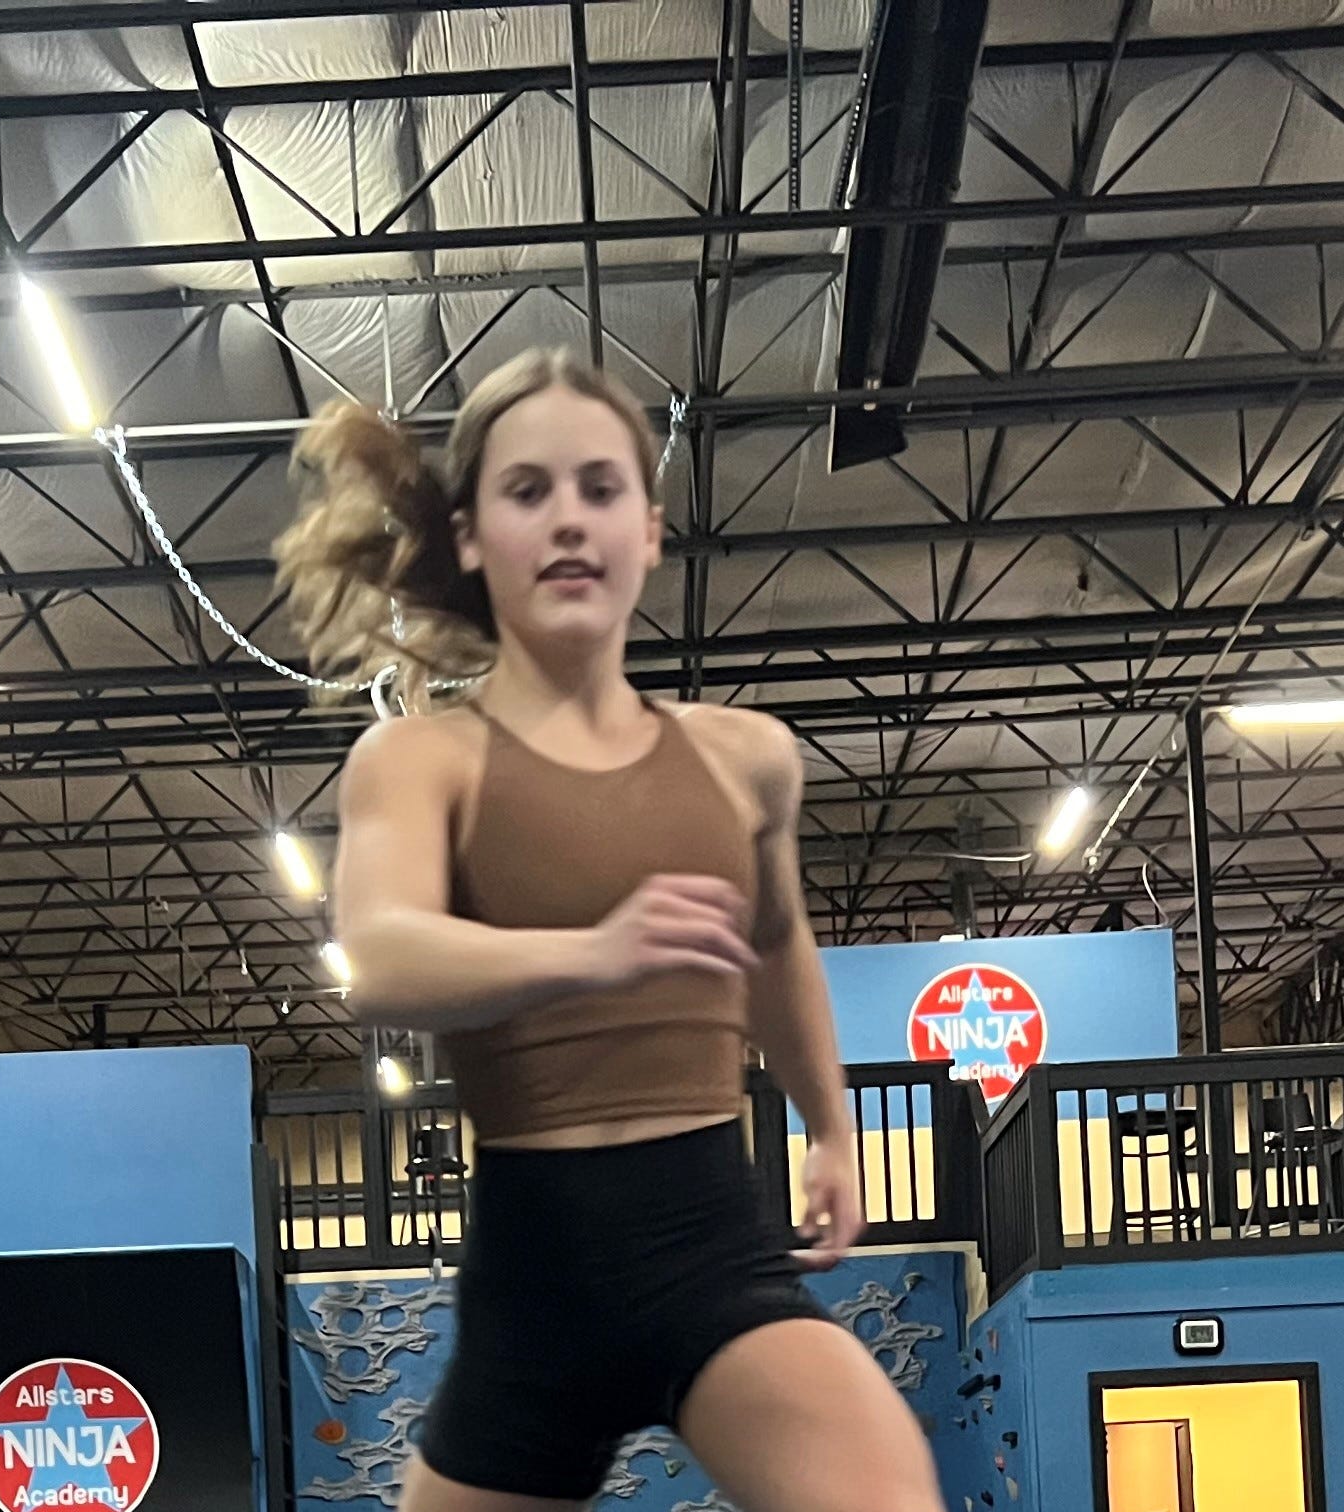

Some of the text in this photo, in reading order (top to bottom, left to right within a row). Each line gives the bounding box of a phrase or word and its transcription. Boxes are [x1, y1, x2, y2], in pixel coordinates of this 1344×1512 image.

[928, 1016, 1029, 1052] NINJA
[949, 1063, 1023, 1082] cademy
[16, 1385, 114, 1408] Allstars
[3, 1425, 136, 1469] NINJA
[13, 1484, 128, 1508] Academy
